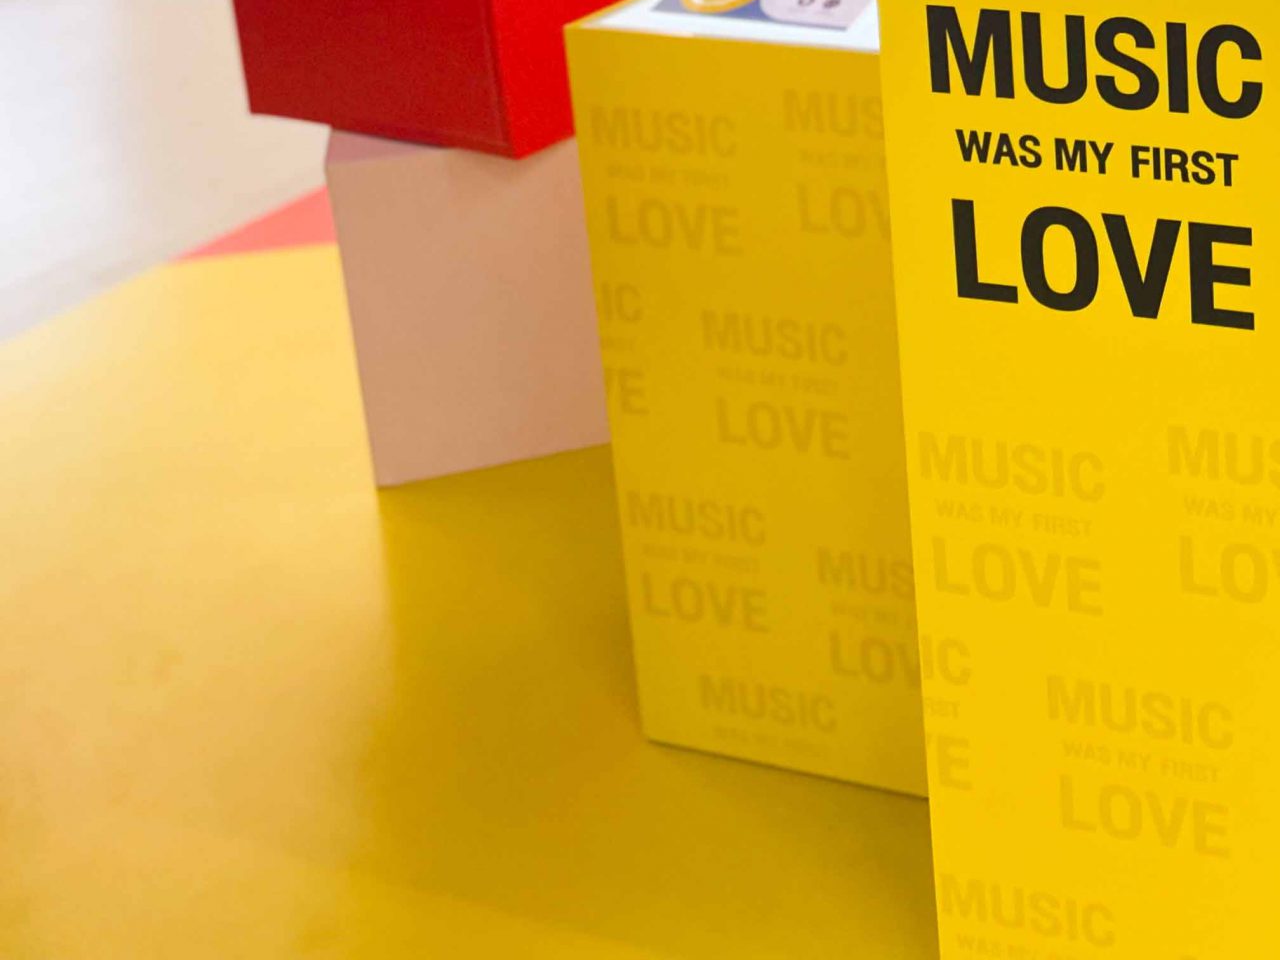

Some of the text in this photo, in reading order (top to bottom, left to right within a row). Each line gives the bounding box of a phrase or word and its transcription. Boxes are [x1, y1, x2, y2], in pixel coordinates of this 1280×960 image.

[926, 4, 1263, 119] MUSIC
[590, 105, 737, 158] MUSIC
[783, 88, 884, 141] MUS
[955, 129, 1239, 187] WAS MY FIRST
[606, 195, 744, 257] LOVE
[951, 197, 1255, 331] LOVE
[701, 309, 848, 367] MUSIC
[715, 396, 851, 461] LOVE
[918, 431, 1106, 503] MUSIC
[627, 490, 765, 548] MUSIC
[935, 498, 1092, 538] WAS MY FIRST
[1183, 494, 1235, 522] WAS
[1243, 503, 1280, 528] MY
[642, 572, 770, 633] LOVE
[816, 545, 915, 603] MUS
[932, 536, 1104, 617] LOVE
[699, 673, 837, 734] MUSIC
[1046, 674, 1234, 750] MUSIC
[1063, 740, 1221, 784] WAS MY FIRST
[1060, 774, 1231, 860] LOVE
[939, 873, 1117, 948] MUSIC
